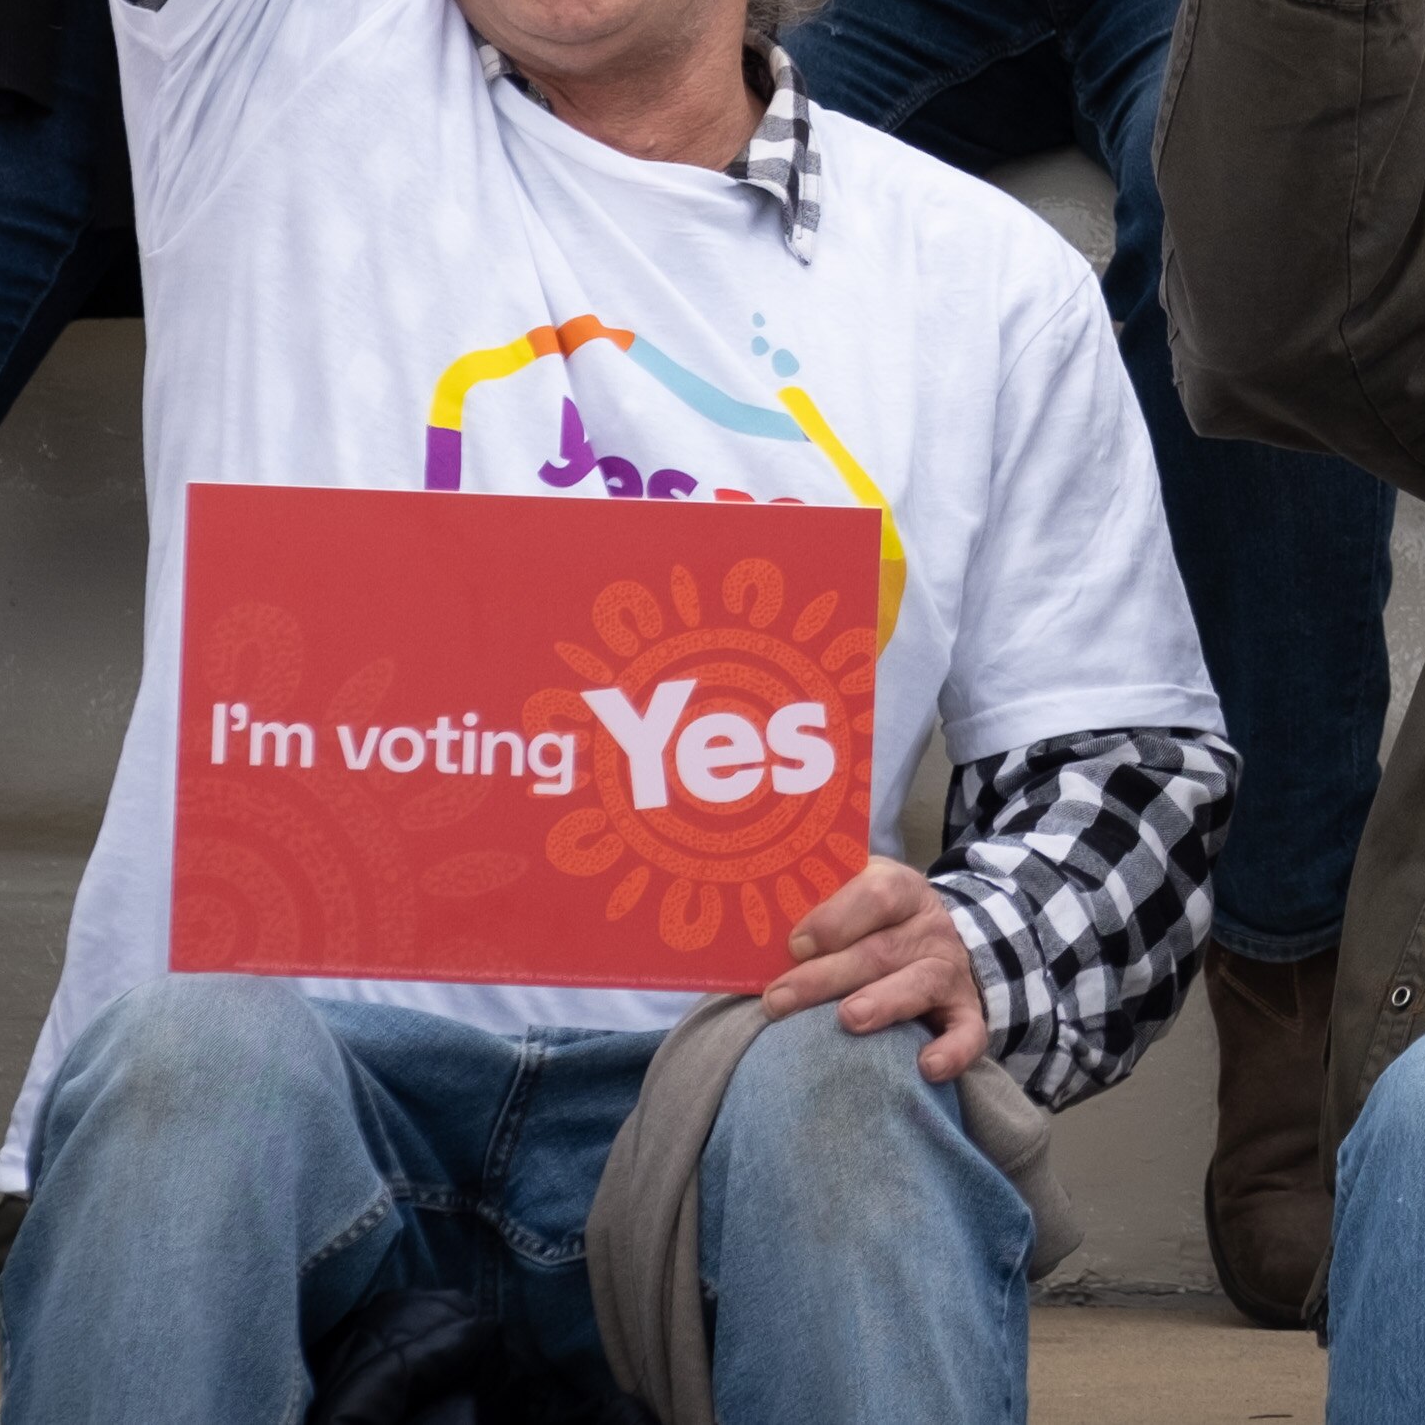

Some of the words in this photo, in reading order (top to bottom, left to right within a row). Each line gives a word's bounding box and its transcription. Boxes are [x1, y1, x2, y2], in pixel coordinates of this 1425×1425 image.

[211, 703, 314, 768] I'm
[336, 712, 575, 795] voting
[580, 678, 836, 810] Yes
